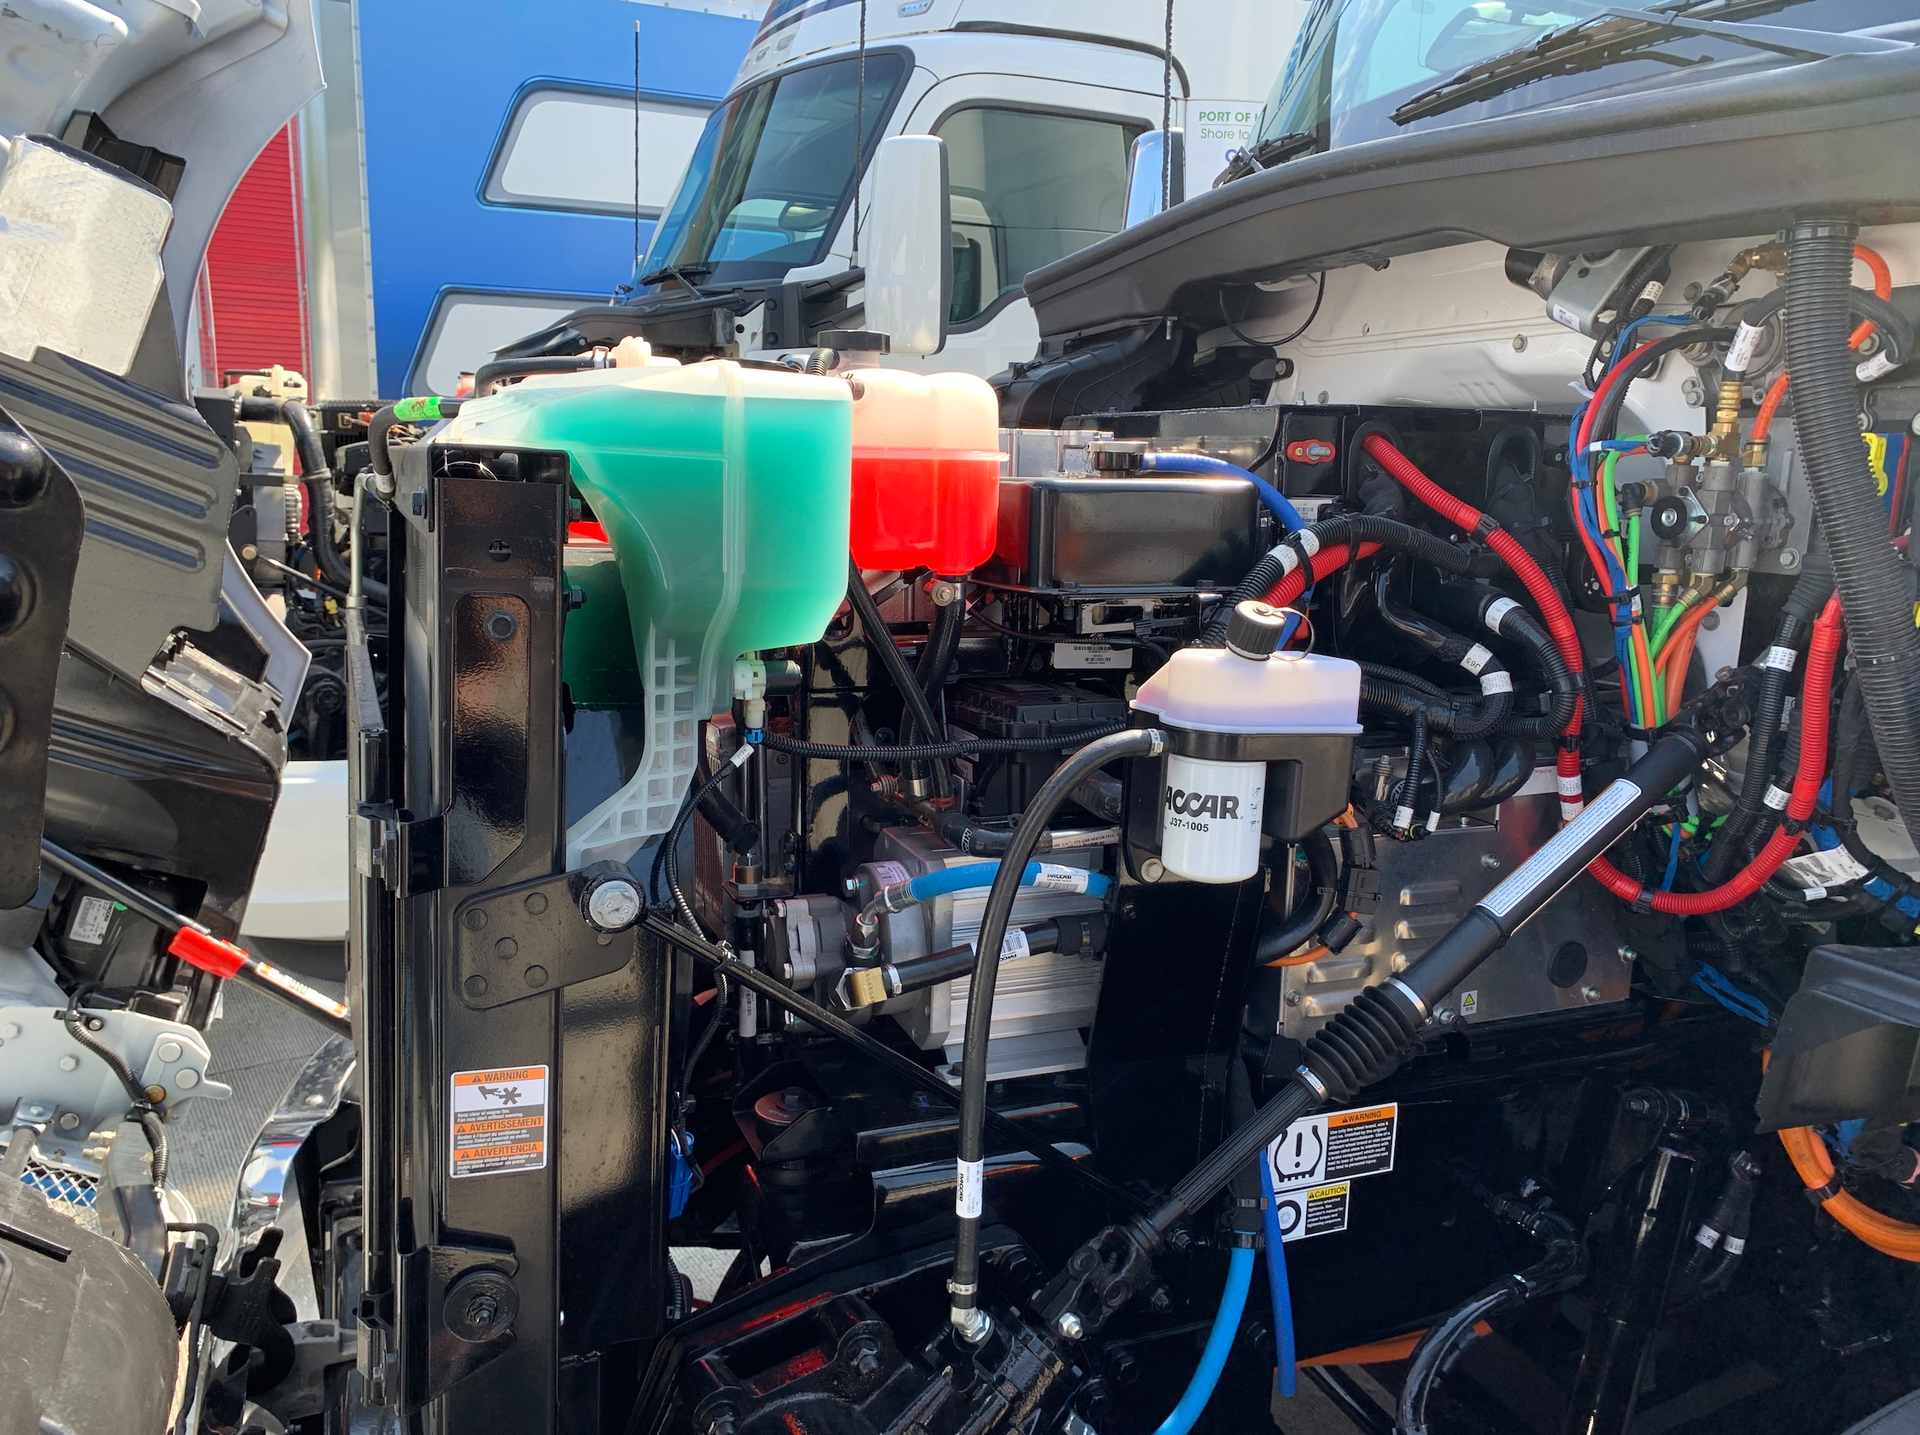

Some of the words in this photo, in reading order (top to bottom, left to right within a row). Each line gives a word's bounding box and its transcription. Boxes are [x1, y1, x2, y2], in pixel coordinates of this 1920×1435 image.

[1199, 111, 1231, 122] PORT
[1234, 112, 1251, 122] OF
[1200, 128, 1235, 139] Shore
[1466, 657, 1481, 669] J65
[1165, 785, 1240, 820] ACCAR
[1169, 817, 1209, 833] J37-1005
[484, 1070, 528, 1082] WARNING
[1348, 1111, 1382, 1122] WARNING
[469, 1117, 541, 1131] AVERTISSEMENT
[473, 1143, 537, 1157] ADVERTENCIA
[1315, 1186, 1347, 1198] CAUTION
